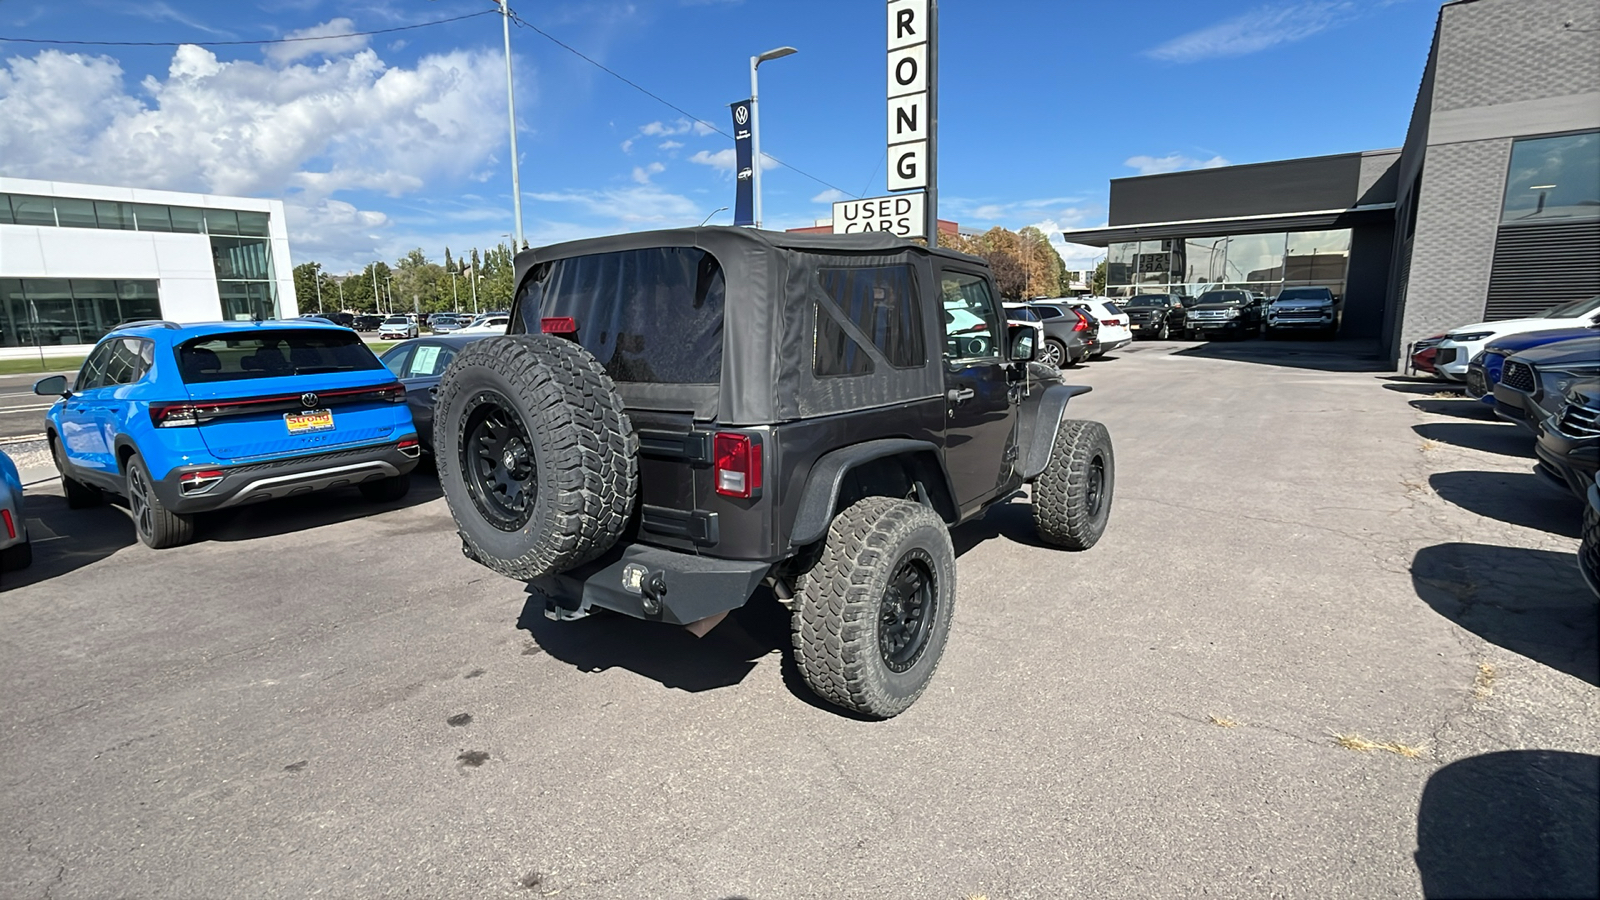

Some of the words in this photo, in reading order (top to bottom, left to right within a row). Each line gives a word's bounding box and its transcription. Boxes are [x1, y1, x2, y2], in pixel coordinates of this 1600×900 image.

[844, 198, 911, 220] USED
[845, 217, 910, 235] CARS
[288, 414, 329, 424] Strong
